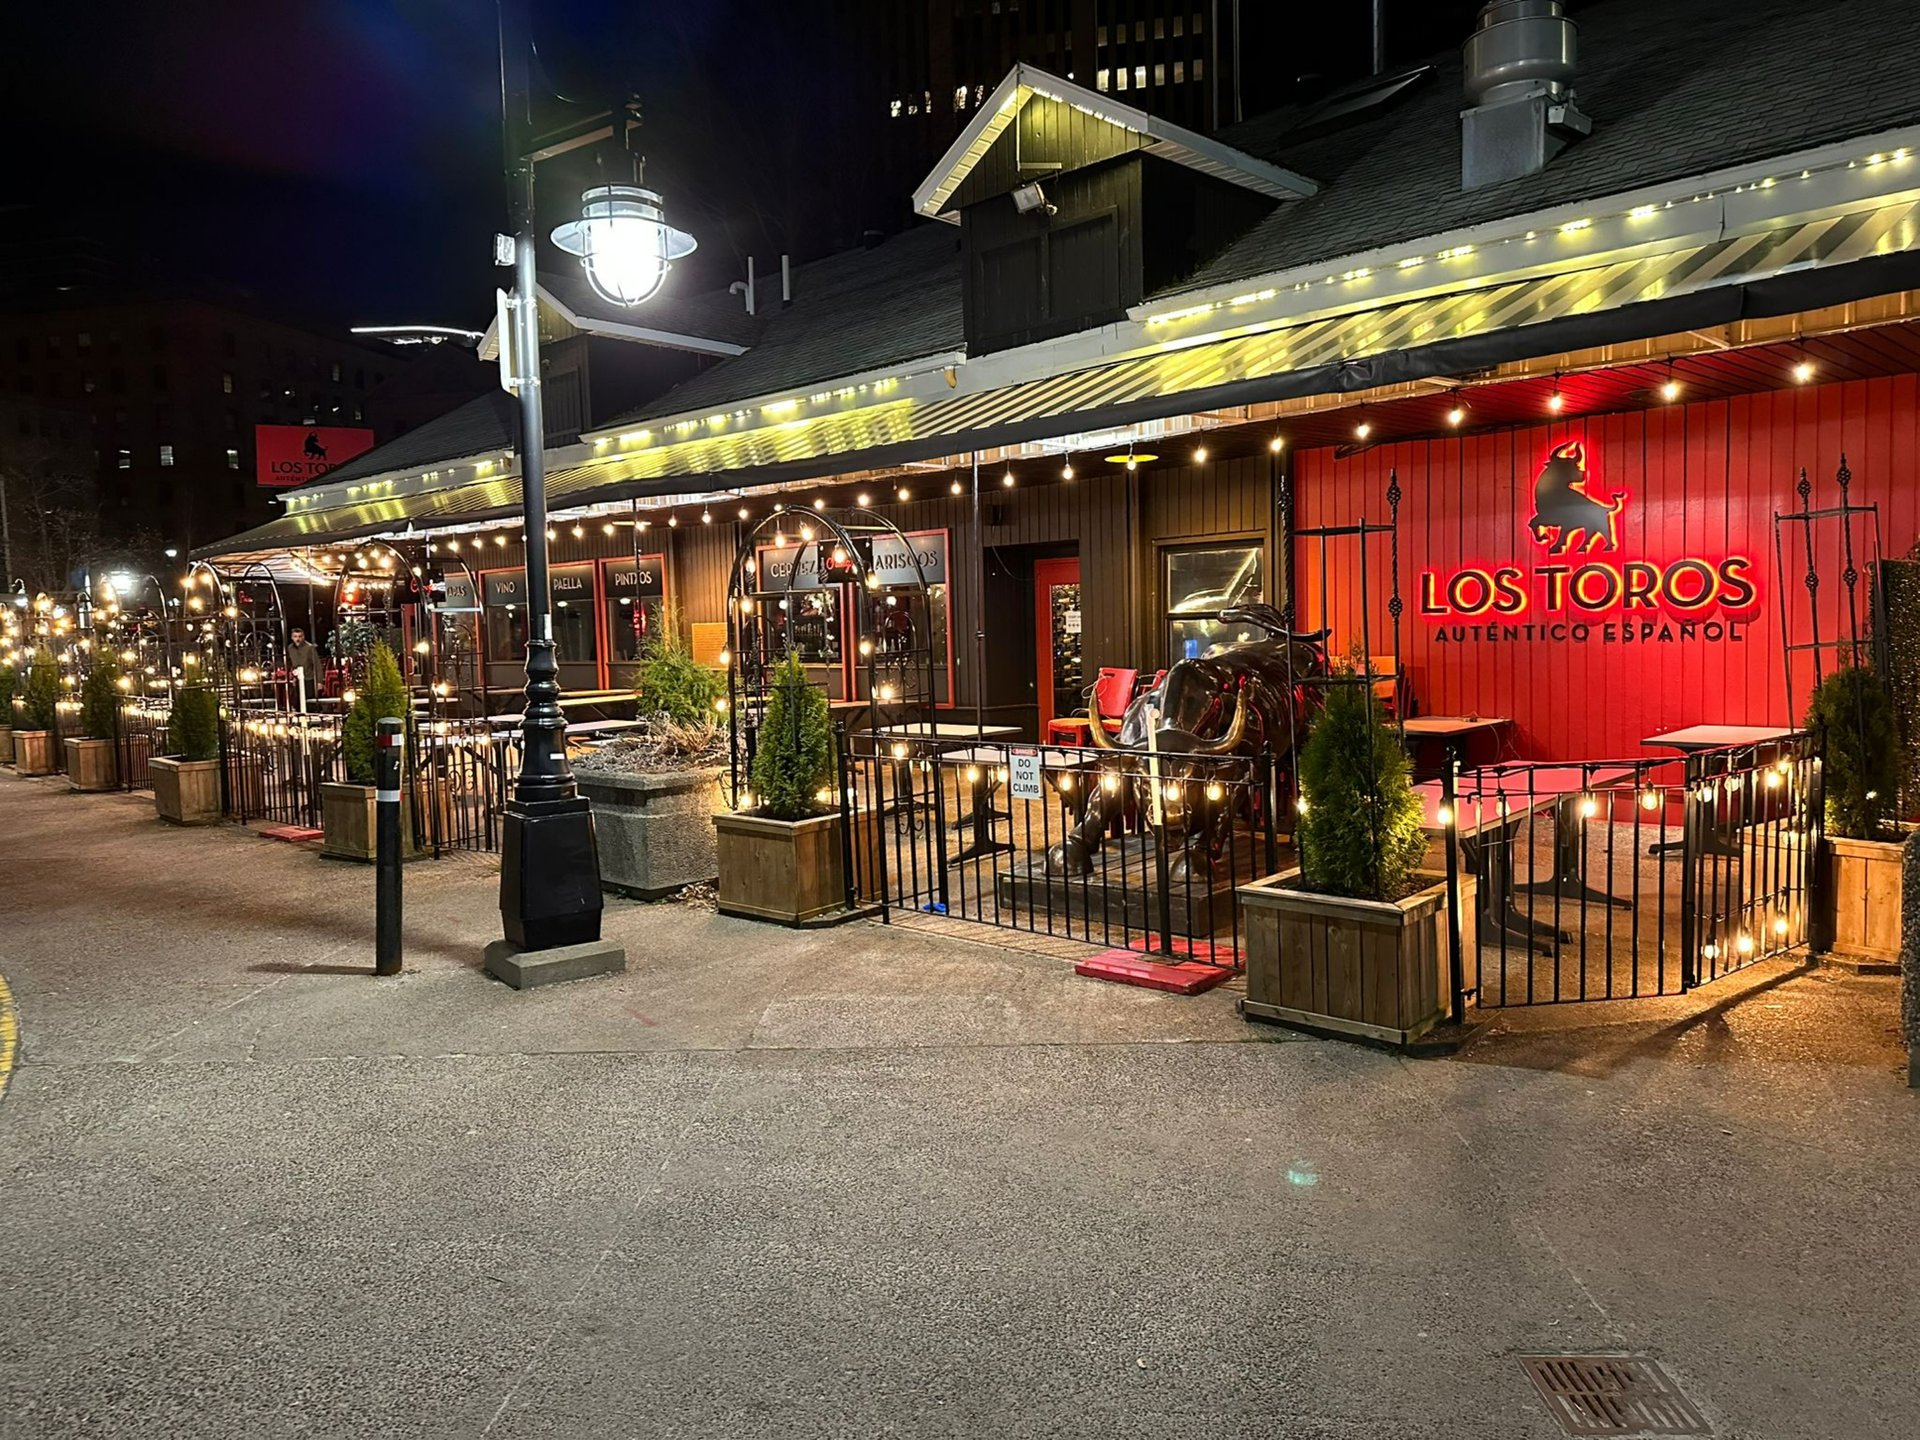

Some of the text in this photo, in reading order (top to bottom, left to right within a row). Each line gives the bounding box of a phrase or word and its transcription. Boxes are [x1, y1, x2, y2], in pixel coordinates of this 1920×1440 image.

[272, 461, 302, 473] LOS
[875, 550, 938, 570] ARISCOS
[495, 581, 516, 594] VINO
[553, 577, 582, 591] PAELLA
[1421, 557, 1756, 615] LOS TOROS
[446, 585, 466, 597] APAS
[1435, 619, 1745, 644] AUTÉNTICO ESPAÑOL
[1018, 758, 1031, 768] DO
[1015, 771, 1034, 781] NOT
[1013, 783, 1039, 793] CLIMB
